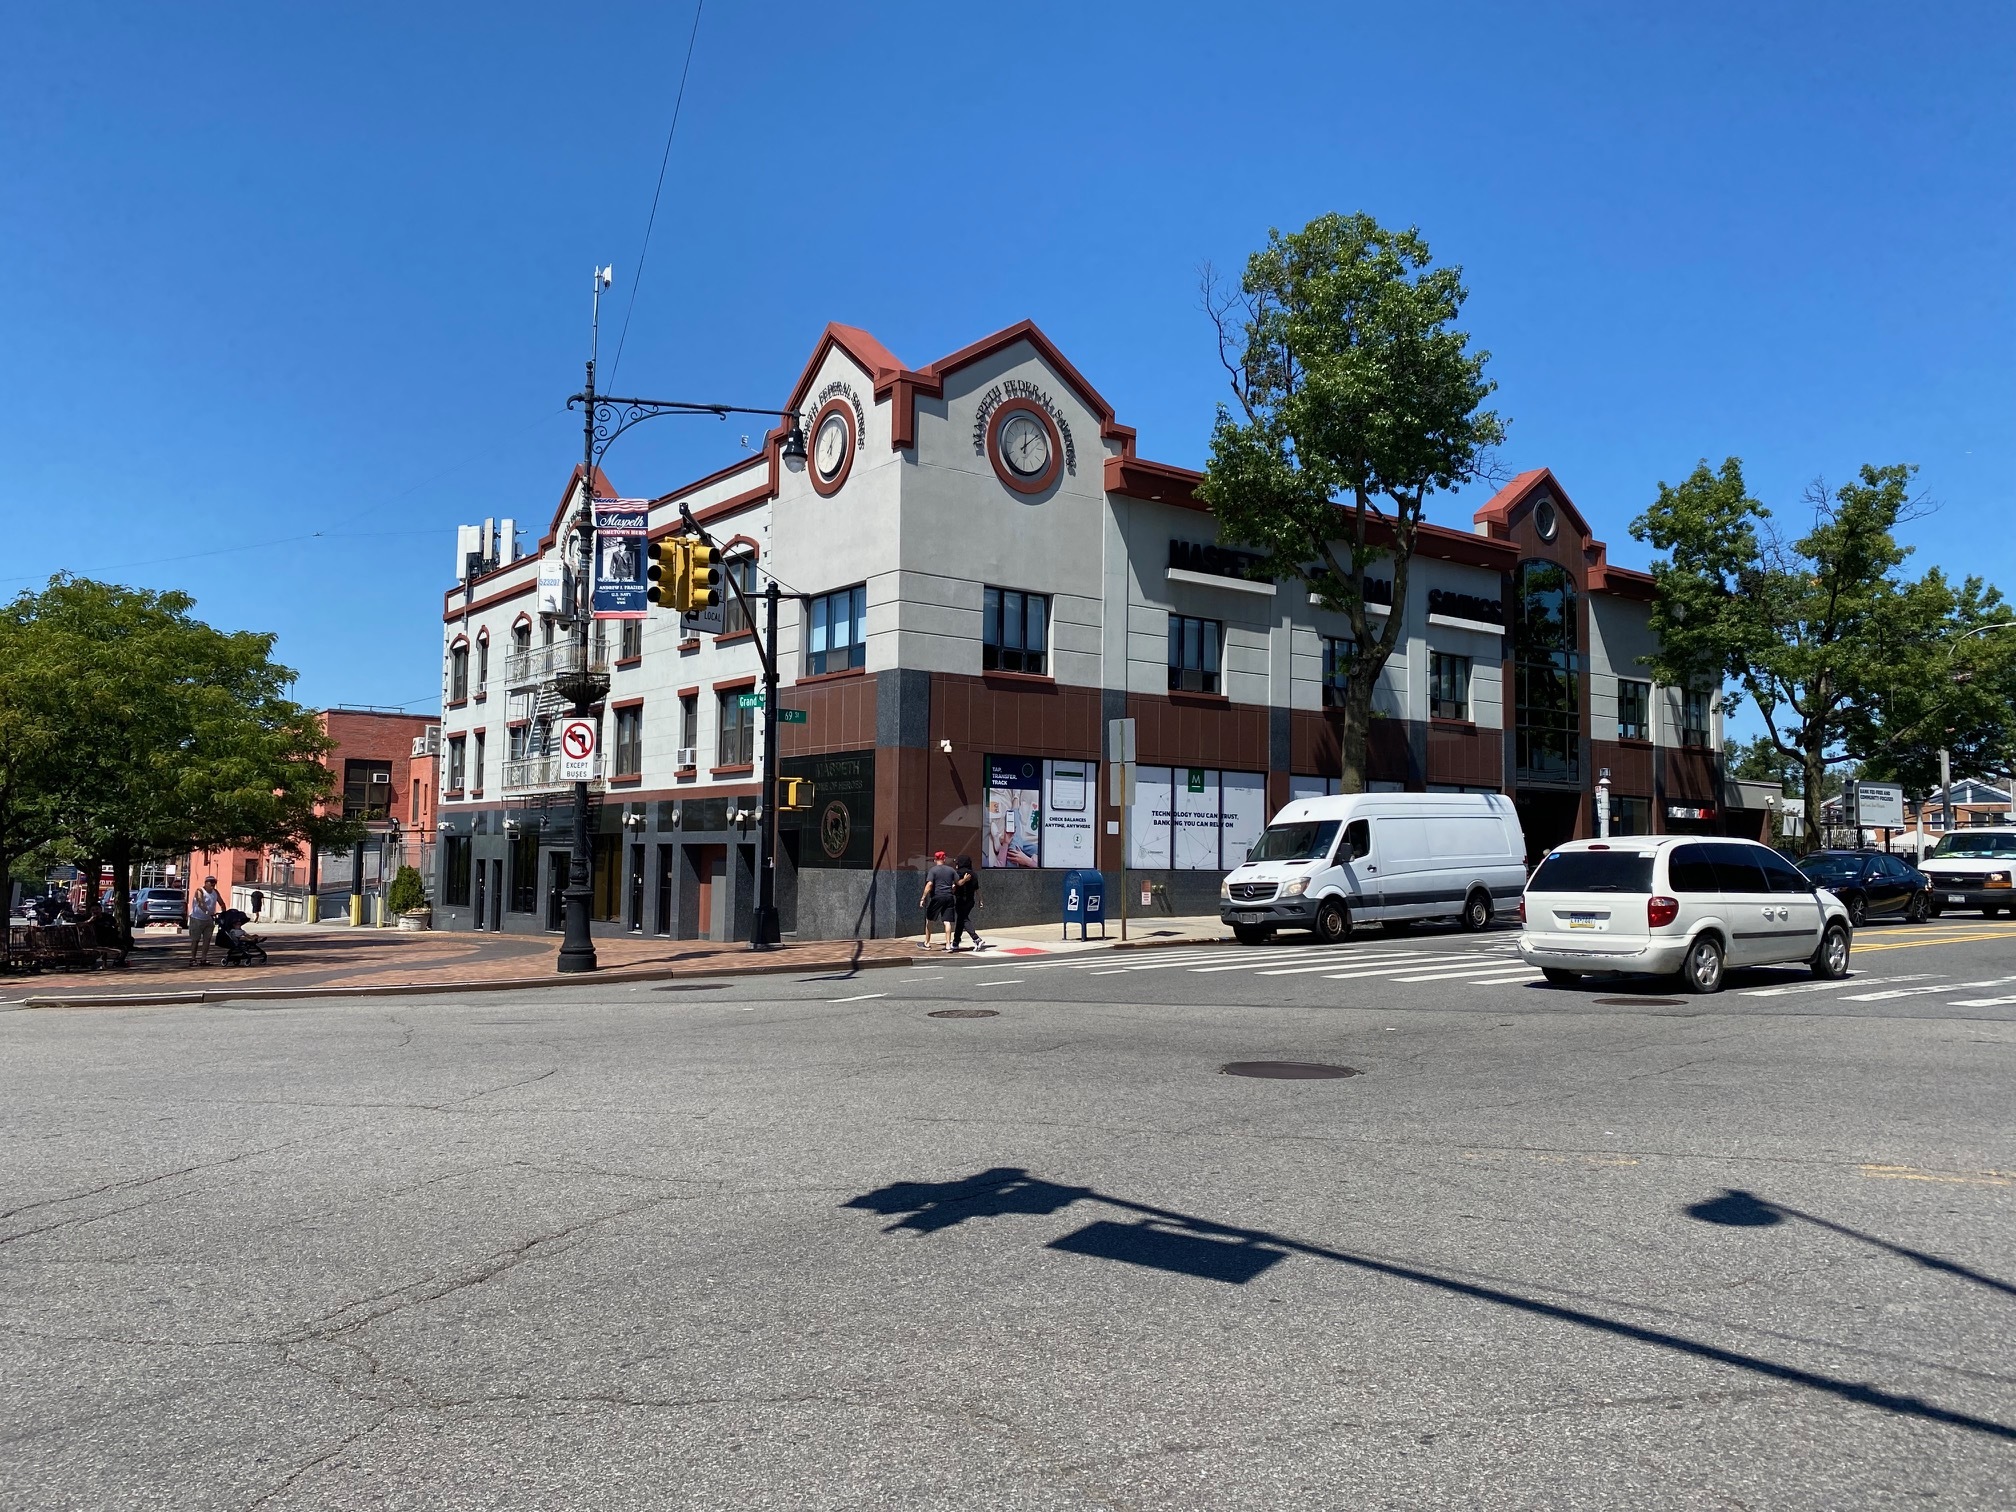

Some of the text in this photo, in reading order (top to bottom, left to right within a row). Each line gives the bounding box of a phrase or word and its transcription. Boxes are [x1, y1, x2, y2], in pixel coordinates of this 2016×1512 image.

[819, 382, 851, 407] FEDERAL
[852, 392, 865, 451] SAVINGS
[973, 380, 1078, 467] MASPETH FEDERAL SAVINGS
[600, 514, 645, 530] Maspeth
[704, 610, 722, 623] LOCAL
[740, 696, 757, 707] Grand
[784, 710, 793, 721] 69
[816, 761, 860, 778] MASPETH
[1192, 775, 1200, 783] M
